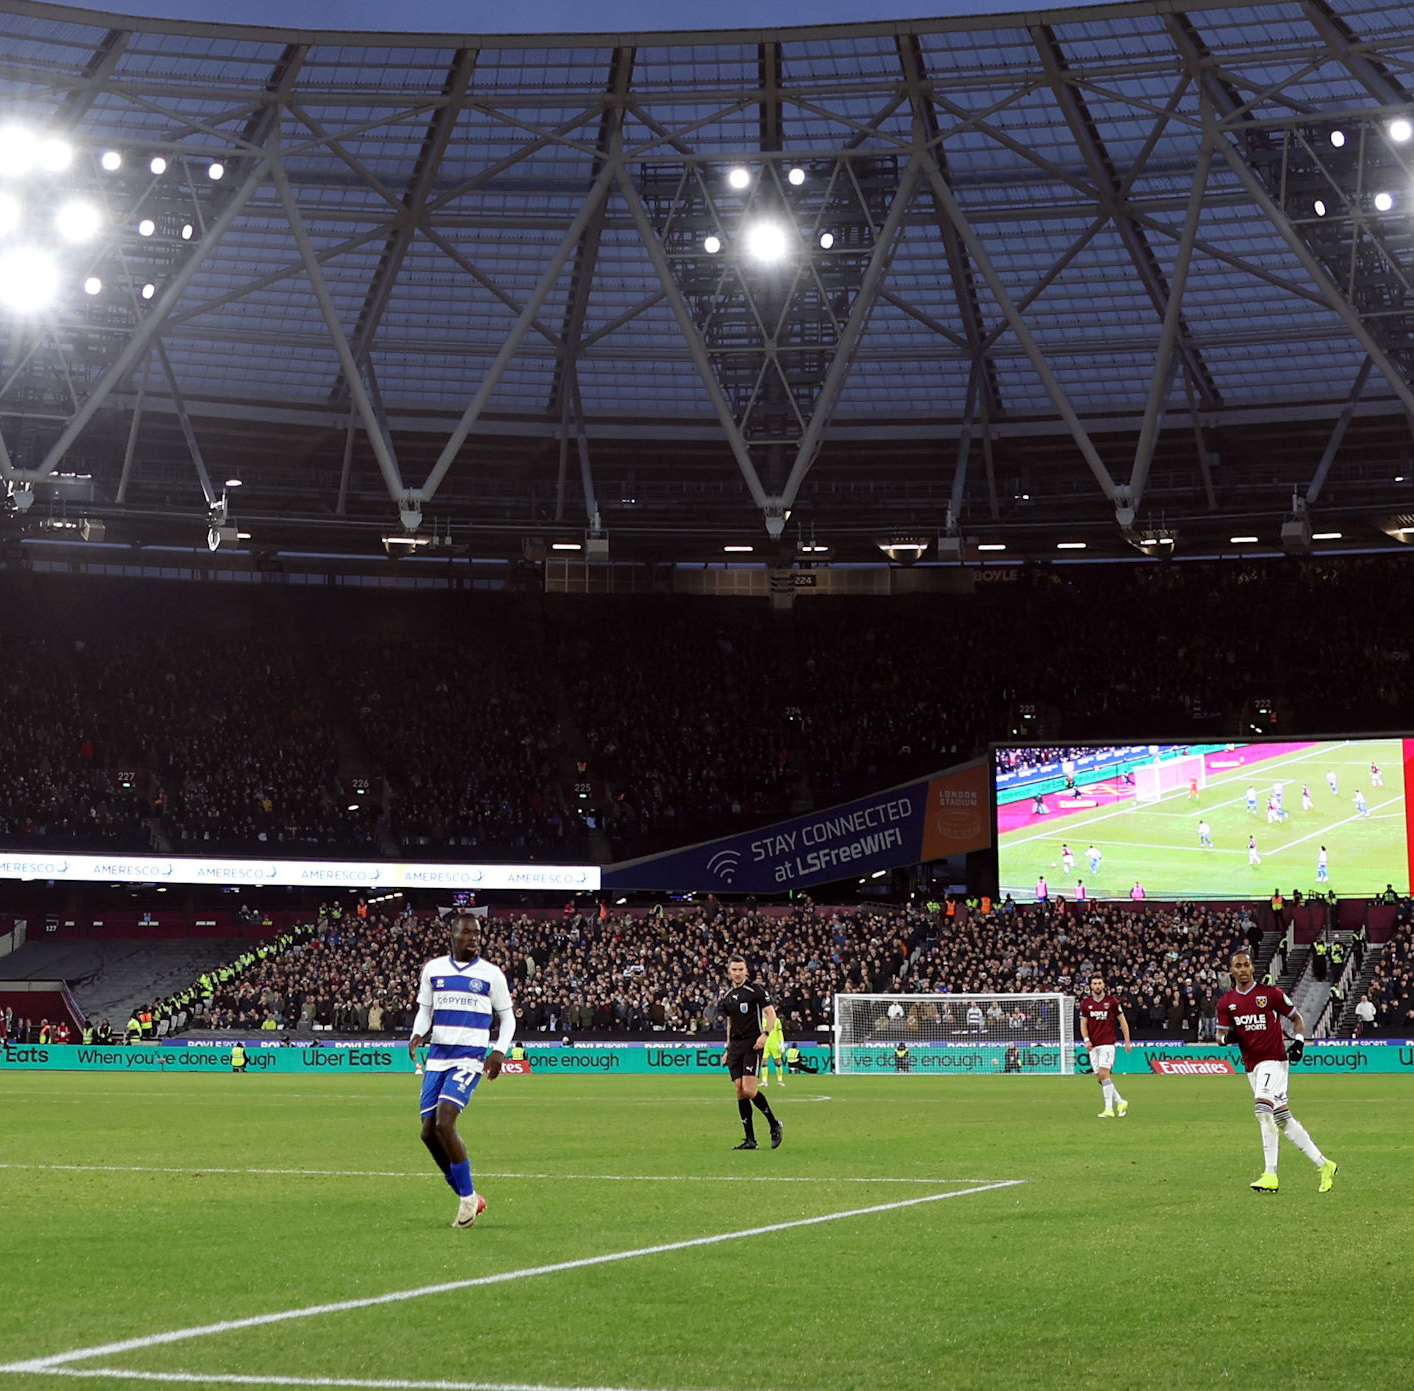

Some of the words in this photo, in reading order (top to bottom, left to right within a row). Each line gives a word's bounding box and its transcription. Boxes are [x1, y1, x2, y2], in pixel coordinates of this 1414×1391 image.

[118, 772, 136, 782] 227
[352, 779, 370, 788] 226
[574, 783, 592, 793] 225
[939, 790, 978, 799] LONDON
[939, 798, 978, 807] STADIUM
[751, 831, 797, 861] STAY
[802, 798, 913, 847] CONNECTED
[93, 864, 160, 876] AMERESCO
[198, 867, 264, 879] AMERESCO
[301, 869, 367, 881] AMERESCO
[775, 861, 795, 882] at
[405, 871, 469, 883] AMERESCO
[507, 872, 573, 884] AMERESCO
[1234, 1013, 1267, 1026] BOYLE
[1245, 1024, 1267, 1032] SPORTS
[6, 1046, 49, 1063] Eats
[77, 1049, 123, 1065] When
[126, 1049, 176, 1068] you've
[178, 1049, 217, 1066] done
[302, 1049, 345, 1066] Uber
[349, 1048, 392, 1066] Eats
[562, 1050, 620, 1070] enough
[647, 1049, 696, 1067] Uber
[881, 1049, 919, 1067] doe
[921, 1049, 983, 1071] enough
[1310, 1050, 1368, 1070] enough
[1158, 1061, 1228, 1075] Emirates
[1264, 1073, 1272, 1087] 7
